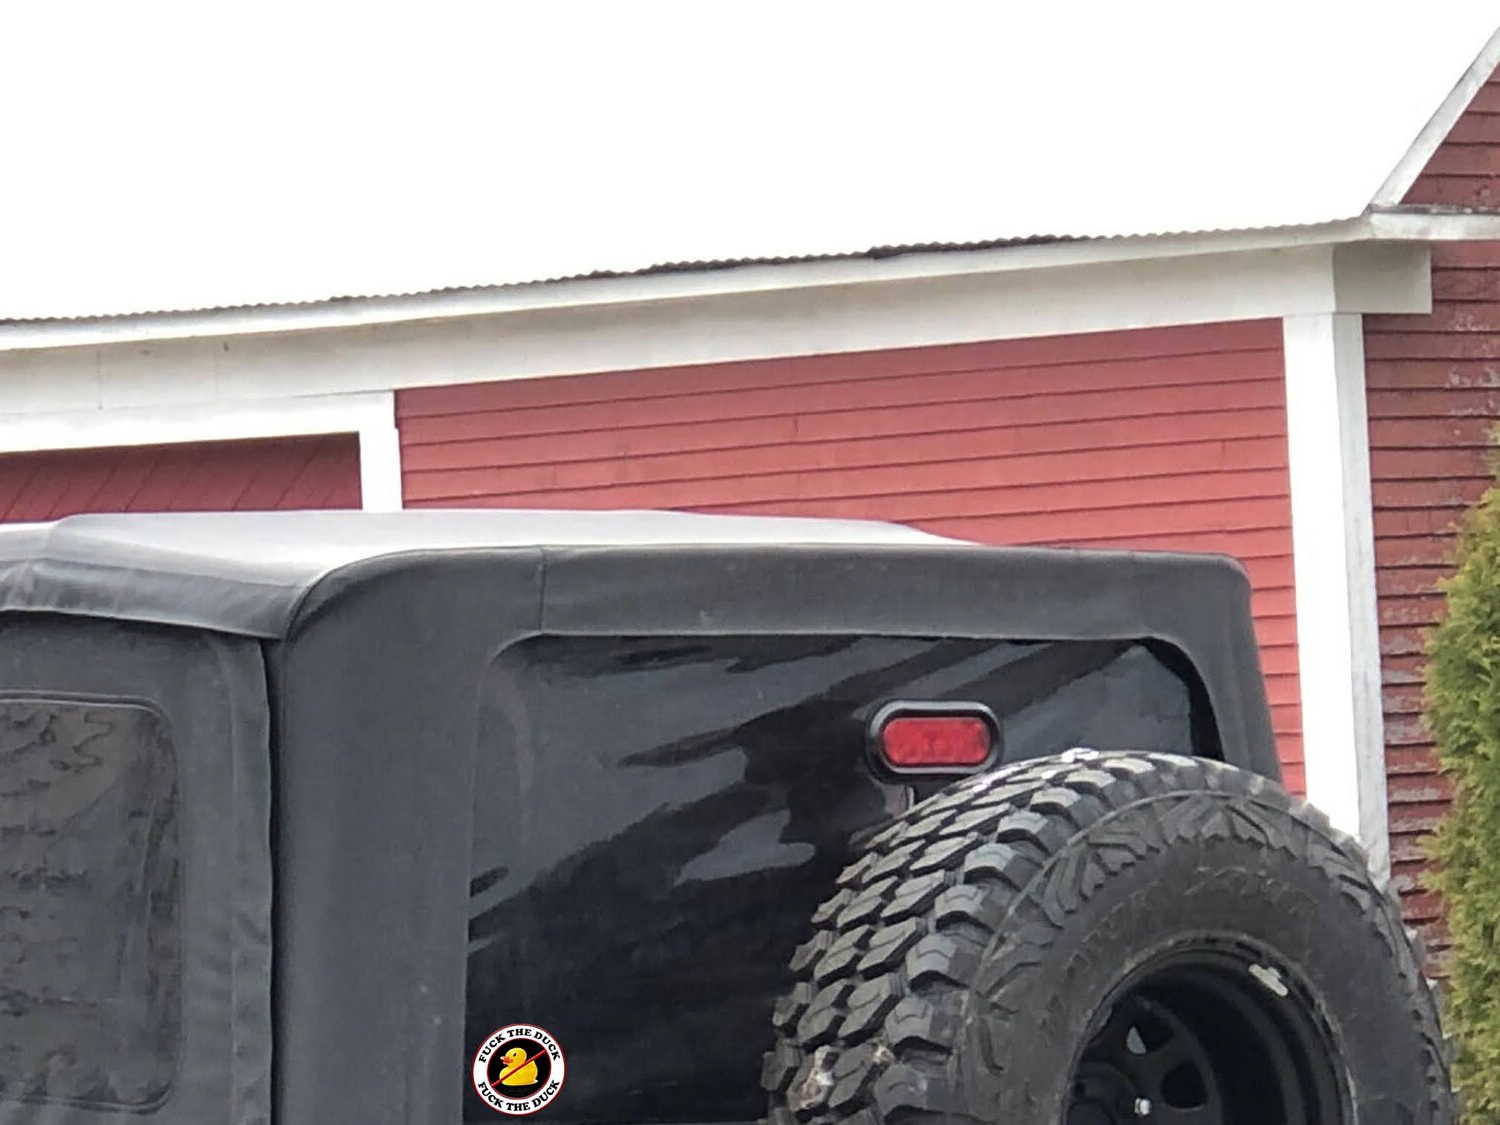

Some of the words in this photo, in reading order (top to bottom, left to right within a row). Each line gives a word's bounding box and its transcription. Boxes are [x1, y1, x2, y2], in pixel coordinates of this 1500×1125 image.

[478, 1033, 506, 1063] FUCK
[506, 1028, 532, 1038] THE
[533, 1031, 561, 1061] DUCK
[478, 1081, 504, 1108] FUCK
[505, 1101, 531, 1112] THE
[532, 1079, 560, 1108] DUCK
